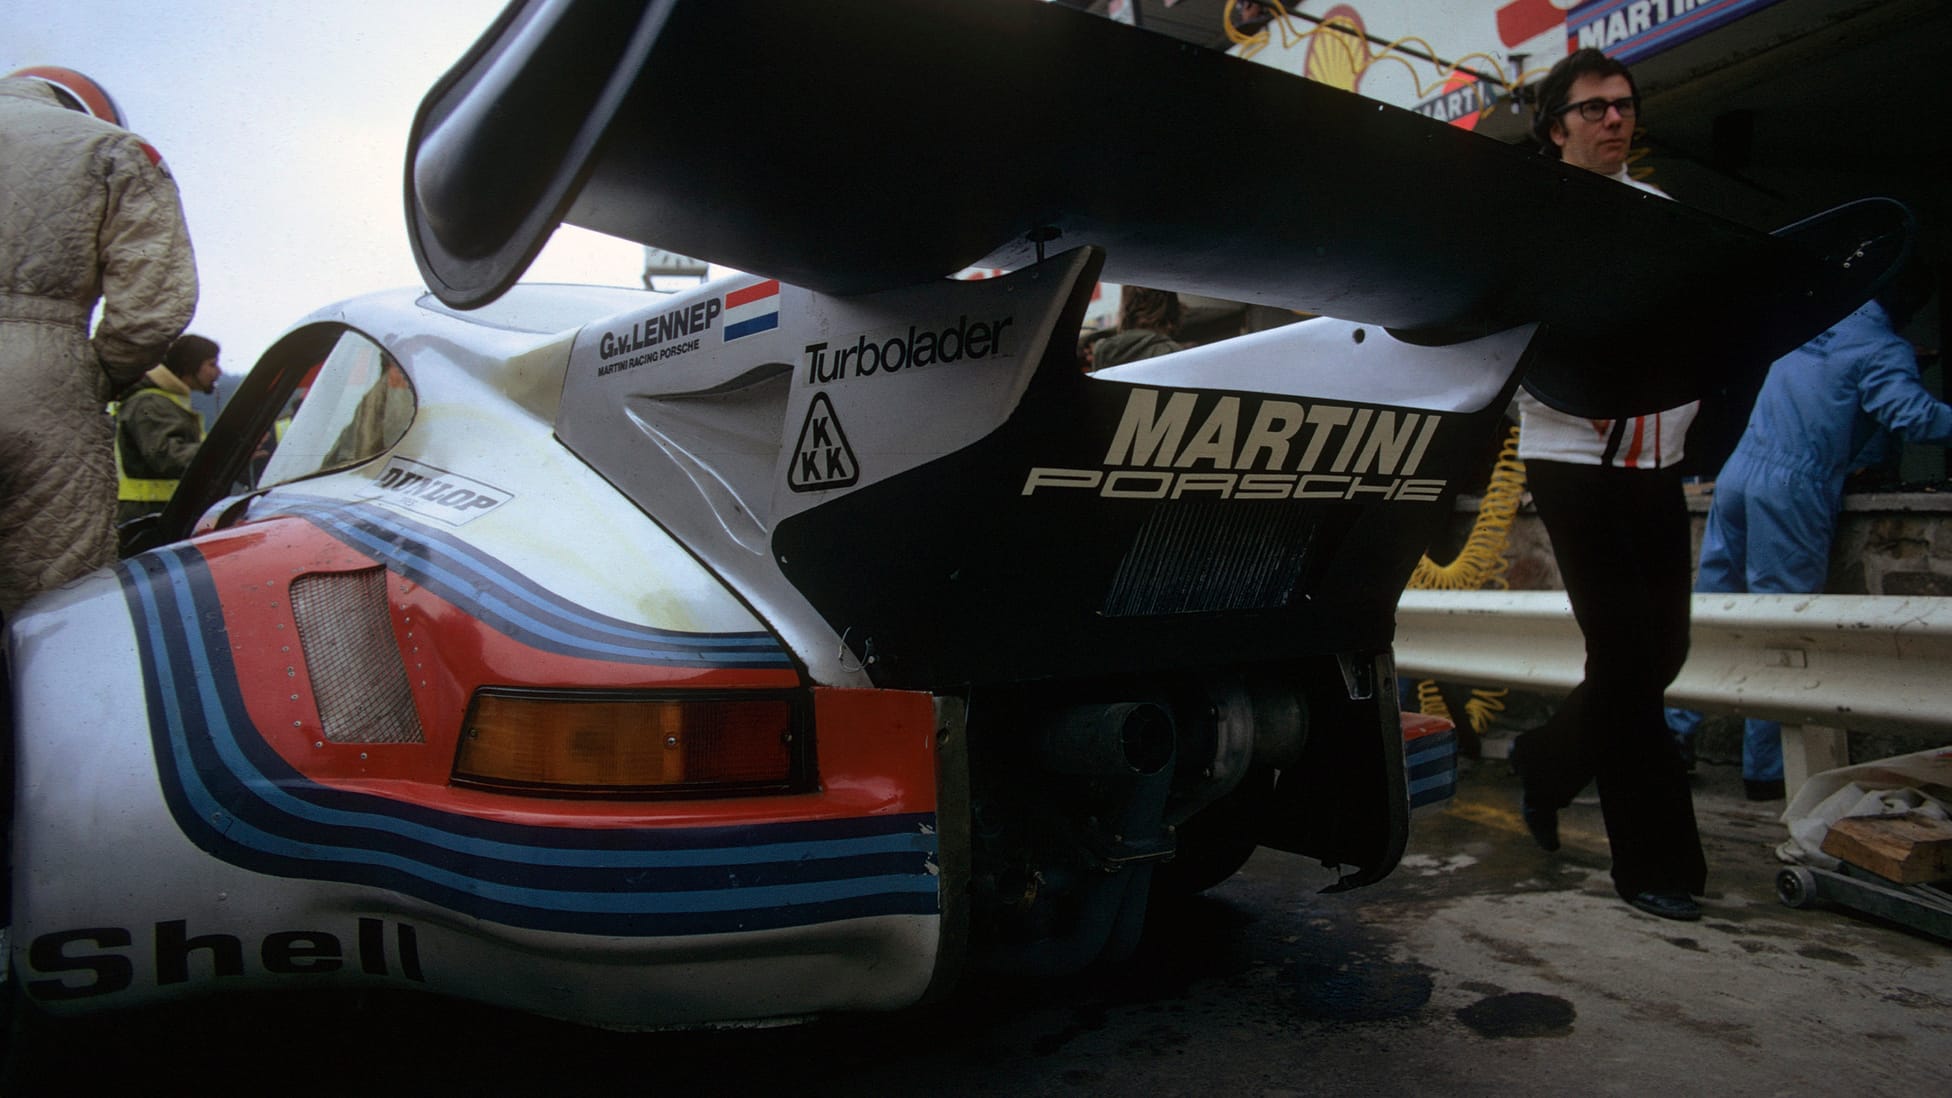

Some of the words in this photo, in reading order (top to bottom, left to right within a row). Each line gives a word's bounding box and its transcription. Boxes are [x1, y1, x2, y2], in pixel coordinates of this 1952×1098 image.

[598, 359, 628, 377] MARTINI
[628, 351, 659, 369] RACING
[660, 339, 700, 360] PORSCHE
[600, 298, 721, 360] G.v.LENNEP
[805, 315, 1013, 384] Turbolader
[1104, 388, 1441, 476] MARTINI
[380, 467, 499, 511] DUNLOP
[1021, 467, 1447, 501] PORSCHE
[27, 918, 425, 1000] Shell
